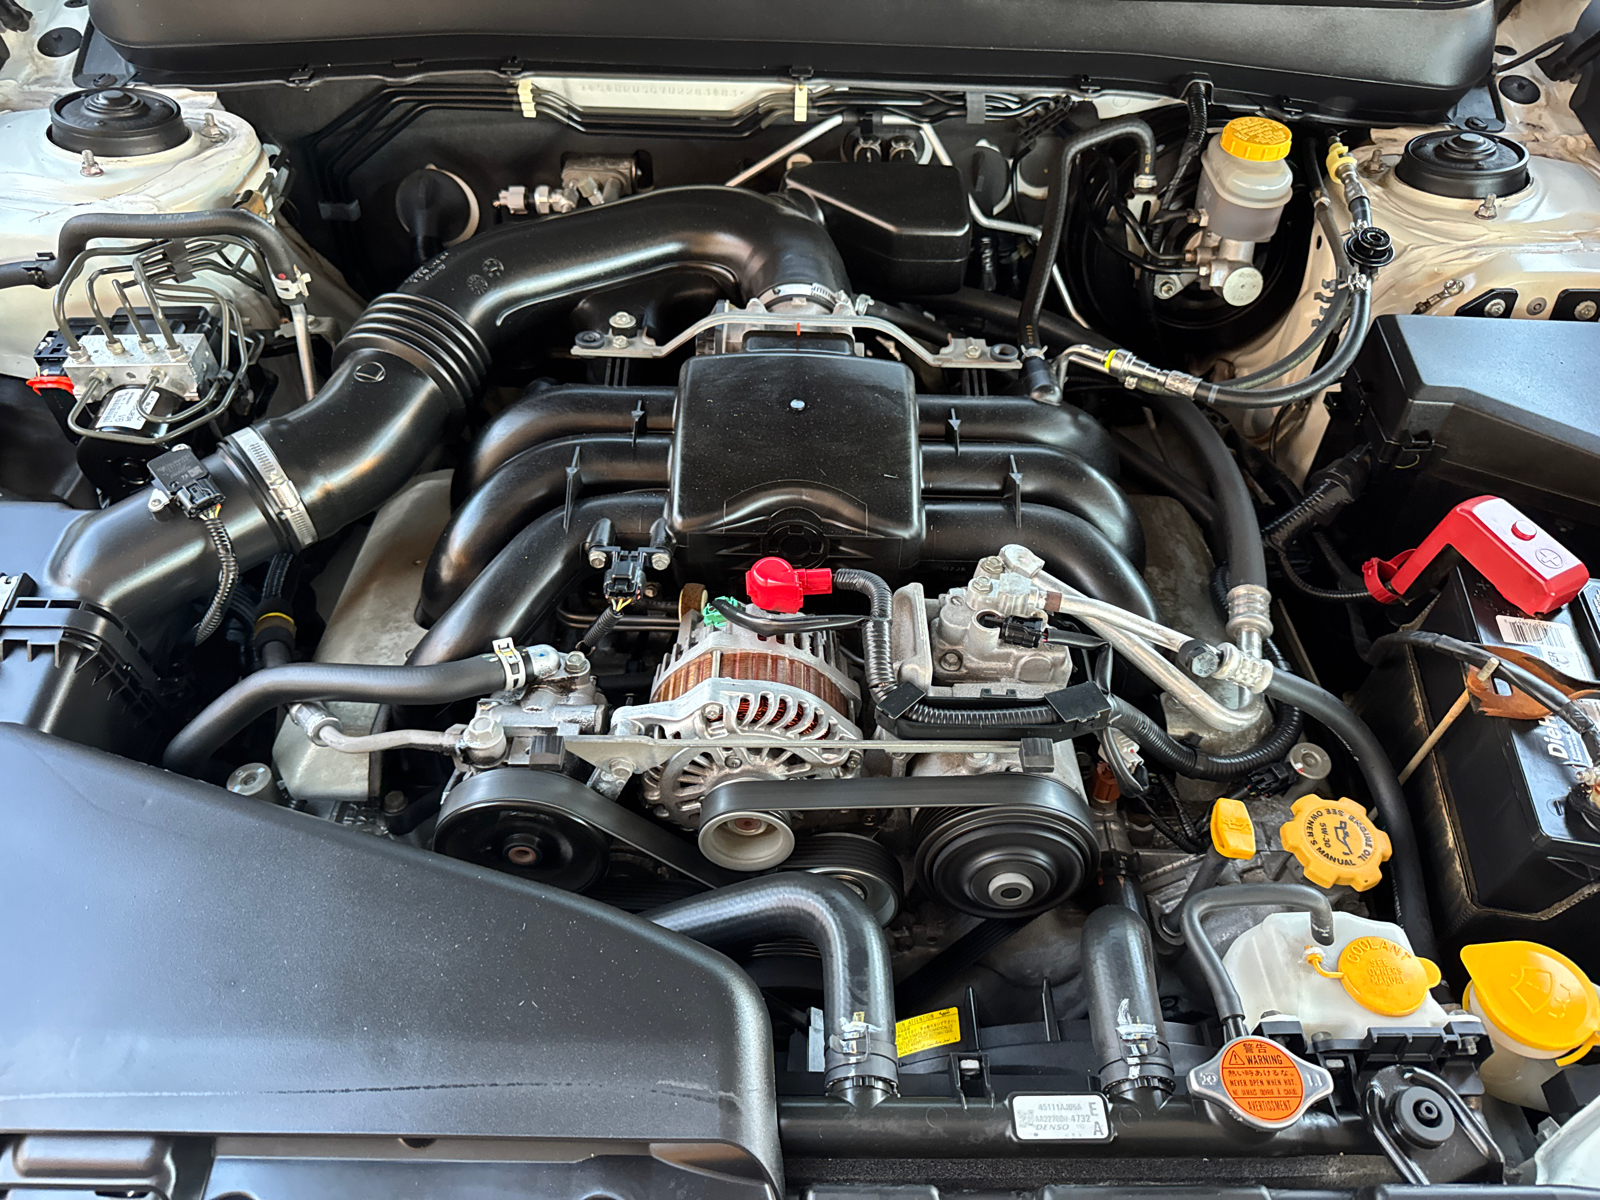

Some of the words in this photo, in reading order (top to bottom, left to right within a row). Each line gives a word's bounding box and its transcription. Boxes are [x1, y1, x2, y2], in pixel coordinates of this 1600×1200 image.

[1325, 808, 1345, 816] SEE
[1305, 810, 1323, 846] OWNER'S
[1348, 815, 1373, 848] ENGINE
[1319, 822, 1331, 848] 5W-30
[1316, 847, 1356, 866] MANUAL
[1358, 849, 1371, 861] OIL
[1346, 938, 1412, 963] COOLANT
[1370, 958, 1388, 966] SEE
[1368, 967, 1402, 976] OWNERS
[1370, 975, 1407, 985] MANUAL
[1243, 1043, 1267, 1053] 警告
[1245, 1055, 1283, 1065] WARNING
[1089, 1102, 1099, 1116] E
[1247, 1100, 1292, 1112] AVERTISSMENT
[1093, 1121, 1104, 1136] A
